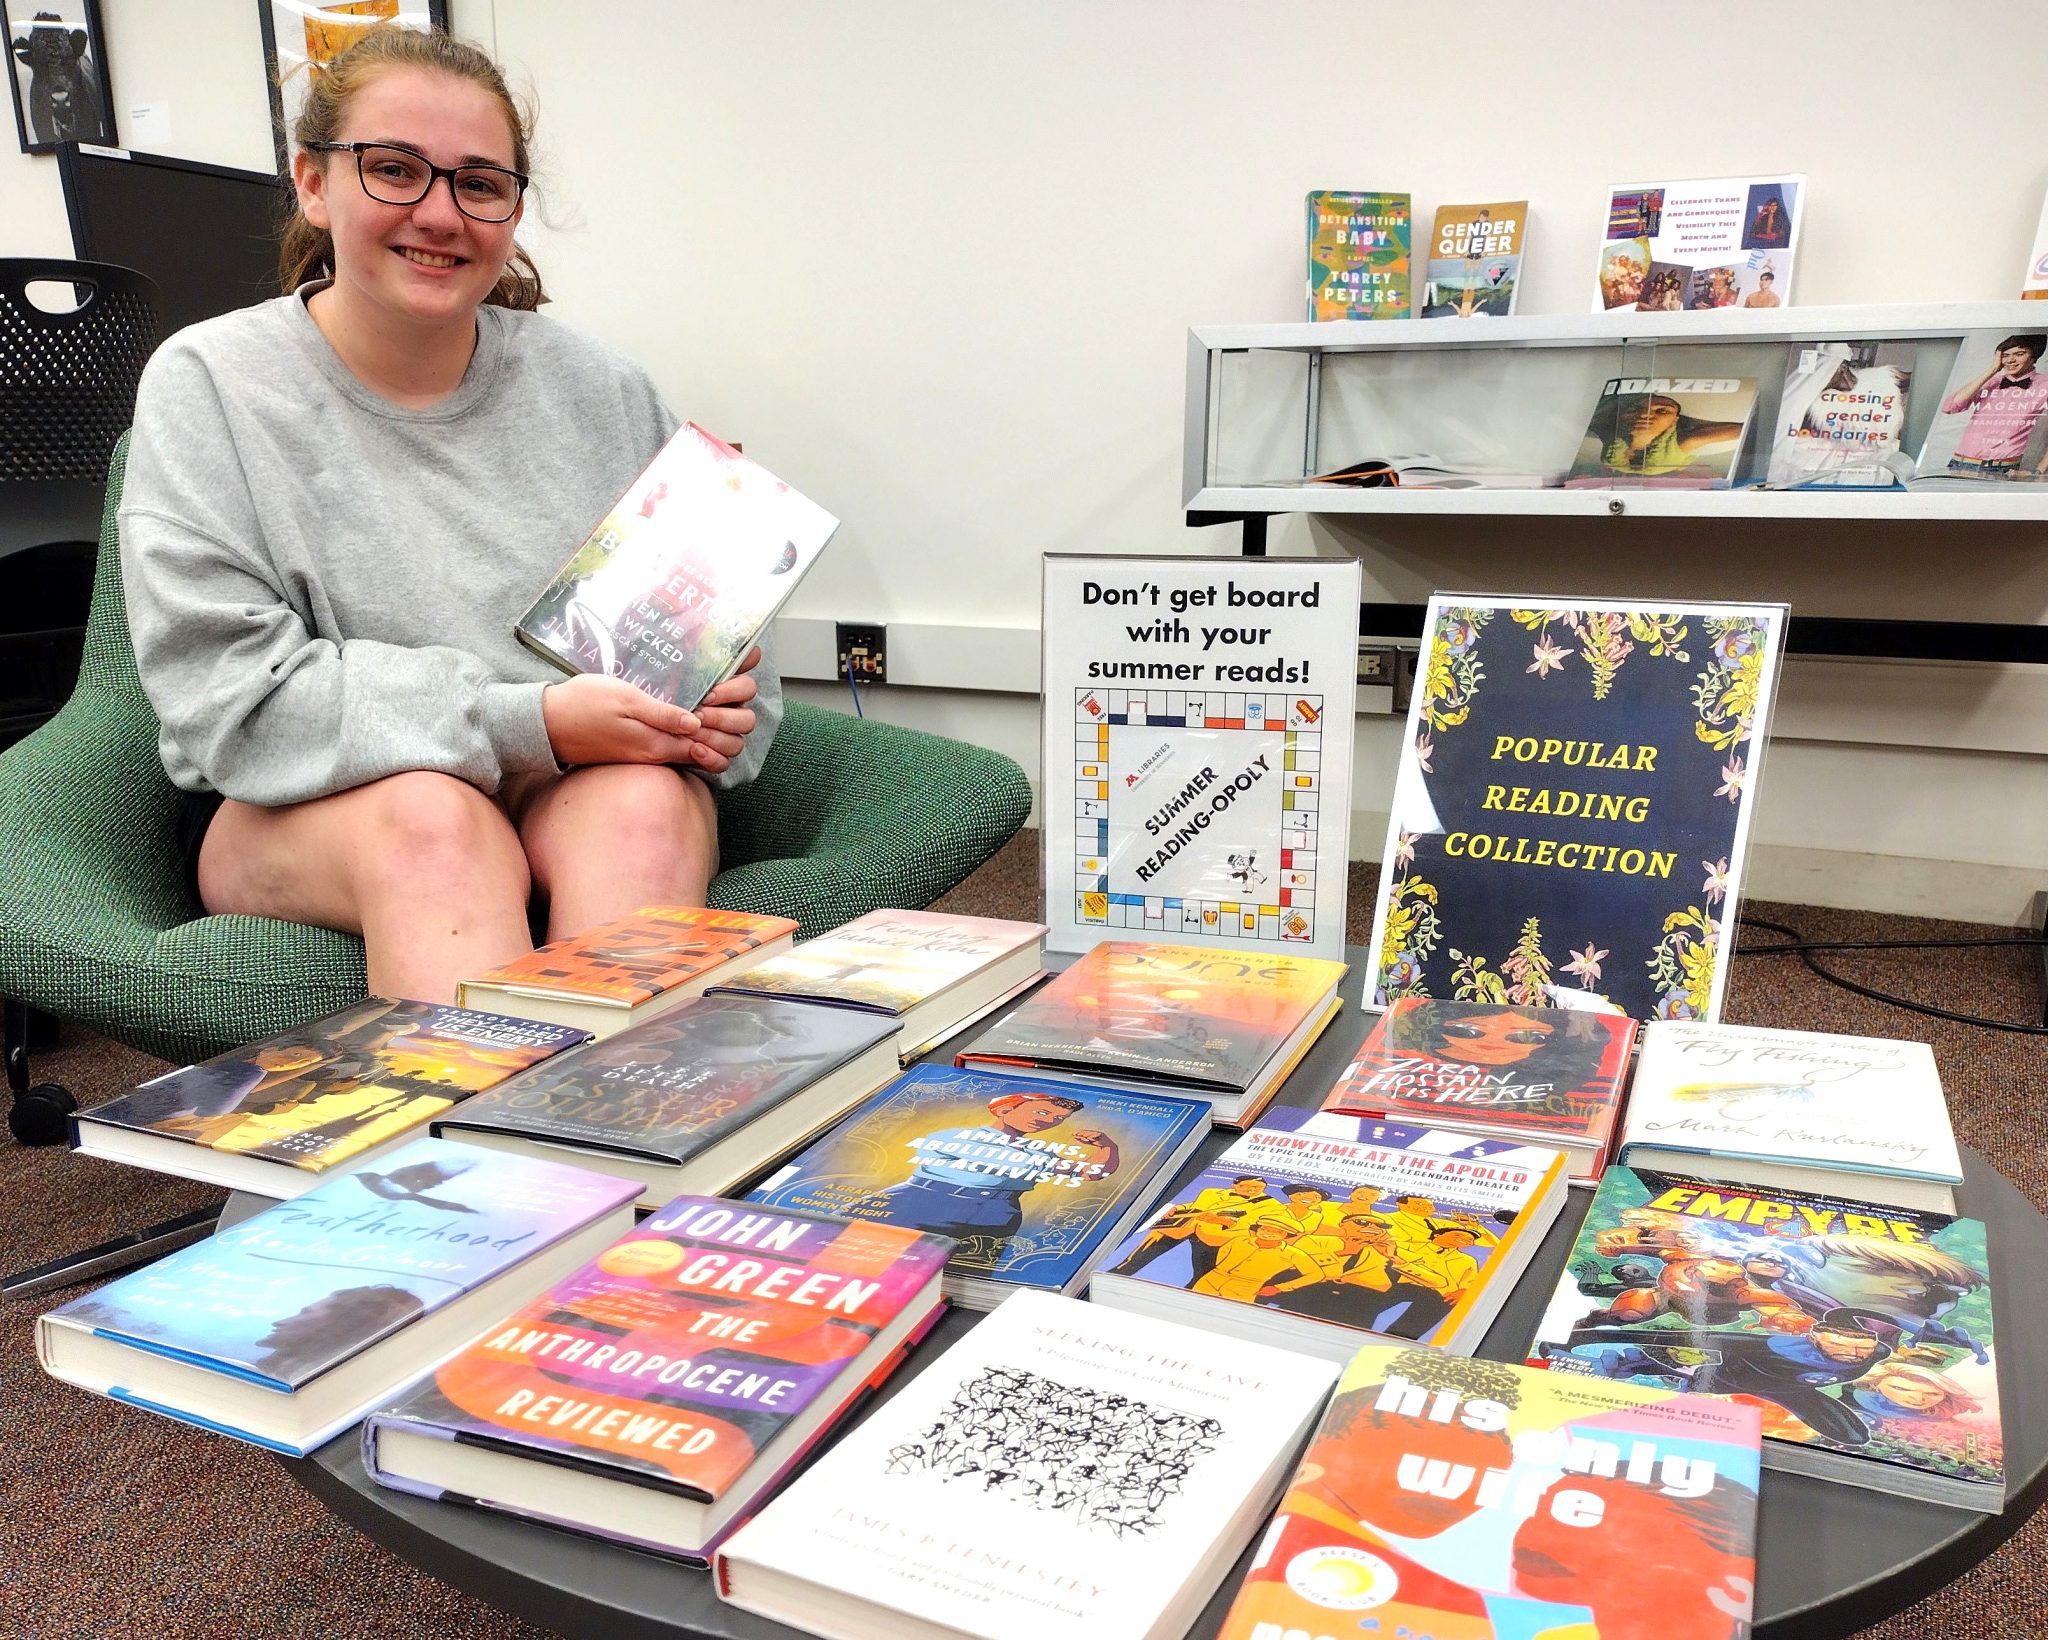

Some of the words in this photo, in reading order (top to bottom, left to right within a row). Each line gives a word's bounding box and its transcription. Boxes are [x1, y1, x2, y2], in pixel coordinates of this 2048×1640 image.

[1320, 215, 1408, 228] DETRANSITION,
[1441, 219, 1516, 237] GENDER
[1336, 230, 1388, 246] BABY
[1438, 236, 1512, 254] QUEER
[1331, 271, 1391, 284] TORREY
[1324, 288, 1397, 302] PETERS
[1617, 379, 1741, 394] DAZED
[1820, 391, 1895, 410] crossing
[1980, 389, 2048, 398] BEYOND
[1826, 410, 1891, 426] gender
[1969, 401, 2048, 411] MAGENTA
[1788, 424, 1888, 442] boundaries
[1083, 582, 1160, 607] Don't
[1170, 583, 1217, 613] get
[1228, 581, 1320, 609] board
[624, 615, 684, 663] WICKED
[661, 618, 685, 640] HE
[1126, 618, 1190, 644] with
[1201, 626, 1272, 651] your
[637, 650, 668, 671] STORY
[1088, 659, 1204, 682] summer
[1216, 658, 1310, 684] reads!
[1138, 743, 1170, 774] LIBRARIES
[1491, 736, 1659, 772] POPULAR
[1145, 766, 1220, 836] SUMMER
[1482, 785, 1651, 824] READING
[1136, 754, 1271, 882] READING-OPOLY
[1445, 832, 1678, 879] COLLECTION
[632, 907, 704, 923] REAL
[708, 916, 779, 930] LIFE
[866, 921, 1000, 944] Finding
[430, 1022, 468, 1033] US
[468, 1026, 553, 1047] ENEMY
[437, 1008, 510, 1024] GEORGE
[519, 1021, 575, 1035] TAKEI
[438, 1014, 494, 1029] THEY
[486, 1023, 564, 1041] CALLED
[1005, 1039, 1038, 1048] BRIAN
[1107, 1050, 1141, 1060] KEVIN
[1156, 1057, 1216, 1068] ANDERSON
[1376, 1058, 1481, 1075] ZARA
[1675, 1040, 1744, 1067] Fly
[1753, 1046, 1880, 1073] Fishing
[601, 1072, 698, 1090] DEATH
[1360, 1071, 1516, 1100] HOSSAIN
[1405, 1088, 1428, 1098] IS
[1434, 1083, 1554, 1105] HERE
[1097, 1098, 1128, 1107] NIKKI
[1128, 1103, 1175, 1113] KENDALL
[1127, 1108, 1172, 1119] D'AMICO
[952, 1129, 1086, 1159] AMAZONS,
[1644, 1118, 1760, 1138] Mark
[1773, 1128, 1930, 1162] Kurlansky
[905, 1137, 1110, 1178] ABOLITIONISTS,
[906, 1154, 948, 1170] AND
[947, 1158, 1084, 1188] ACTIVISTS
[1248, 1144, 1267, 1153] THE
[1269, 1147, 1288, 1156] EPIC
[1291, 1150, 1324, 1160] TALE
[1342, 1157, 1398, 1172] HARLEM'S
[1400, 1166, 1466, 1183] LEGENDARY
[1468, 1176, 1520, 1192] THEATER
[1249, 1133, 1364, 1158] SHOWTIME
[1364, 1151, 1392, 1162] AT
[1397, 1154, 1437, 1171] THE
[1441, 1163, 1528, 1185] APOLLO
[1248, 1152, 1267, 1161] BY
[1269, 1156, 1294, 1165] TED
[1296, 1160, 1322, 1169] FOX
[1410, 1178, 1444, 1188] JAMES
[1471, 1187, 1504, 1199] SMITH
[790, 1196, 852, 1213] WOMEN'S
[851, 1207, 894, 1218] FIGHT
[812, 1190, 870, 1205] HISTORY
[835, 1185, 894, 1200] GRAPHIC
[1680, 1184, 1761, 1200] AVENGERS
[1776, 1198, 1866, 1215] FANTASTIC
[1867, 1210, 1912, 1222] FOUR
[272, 1197, 537, 1252] Featherhood
[650, 1204, 813, 1255] JOHN
[678, 1251, 882, 1318] GREEN
[687, 1312, 770, 1344] THE
[486, 1326, 797, 1408] ANTHROPOCENE
[1034, 1326, 1134, 1358] SEEKING
[1146, 1354, 1193, 1371] THE
[1204, 1369, 1267, 1391] CAVE
[1560, 1356, 1592, 1366] EWING
[1566, 1363, 1595, 1372] SLOTT
[1374, 1374, 1509, 1434] his
[1566, 1391, 1676, 1414] MESMERIZING
[1579, 1400, 1602, 1409] New
[1606, 1404, 1630, 1414] York
[1633, 1409, 1664, 1418] Times
[1667, 1415, 1695, 1424] Book
[1697, 1420, 1737, 1430] Review
[498, 1388, 717, 1457] REVIEWED
[1513, 1427, 1716, 1498] only
[1398, 1452, 1604, 1528] wife
[831, 1506, 907, 1538] JAMES
